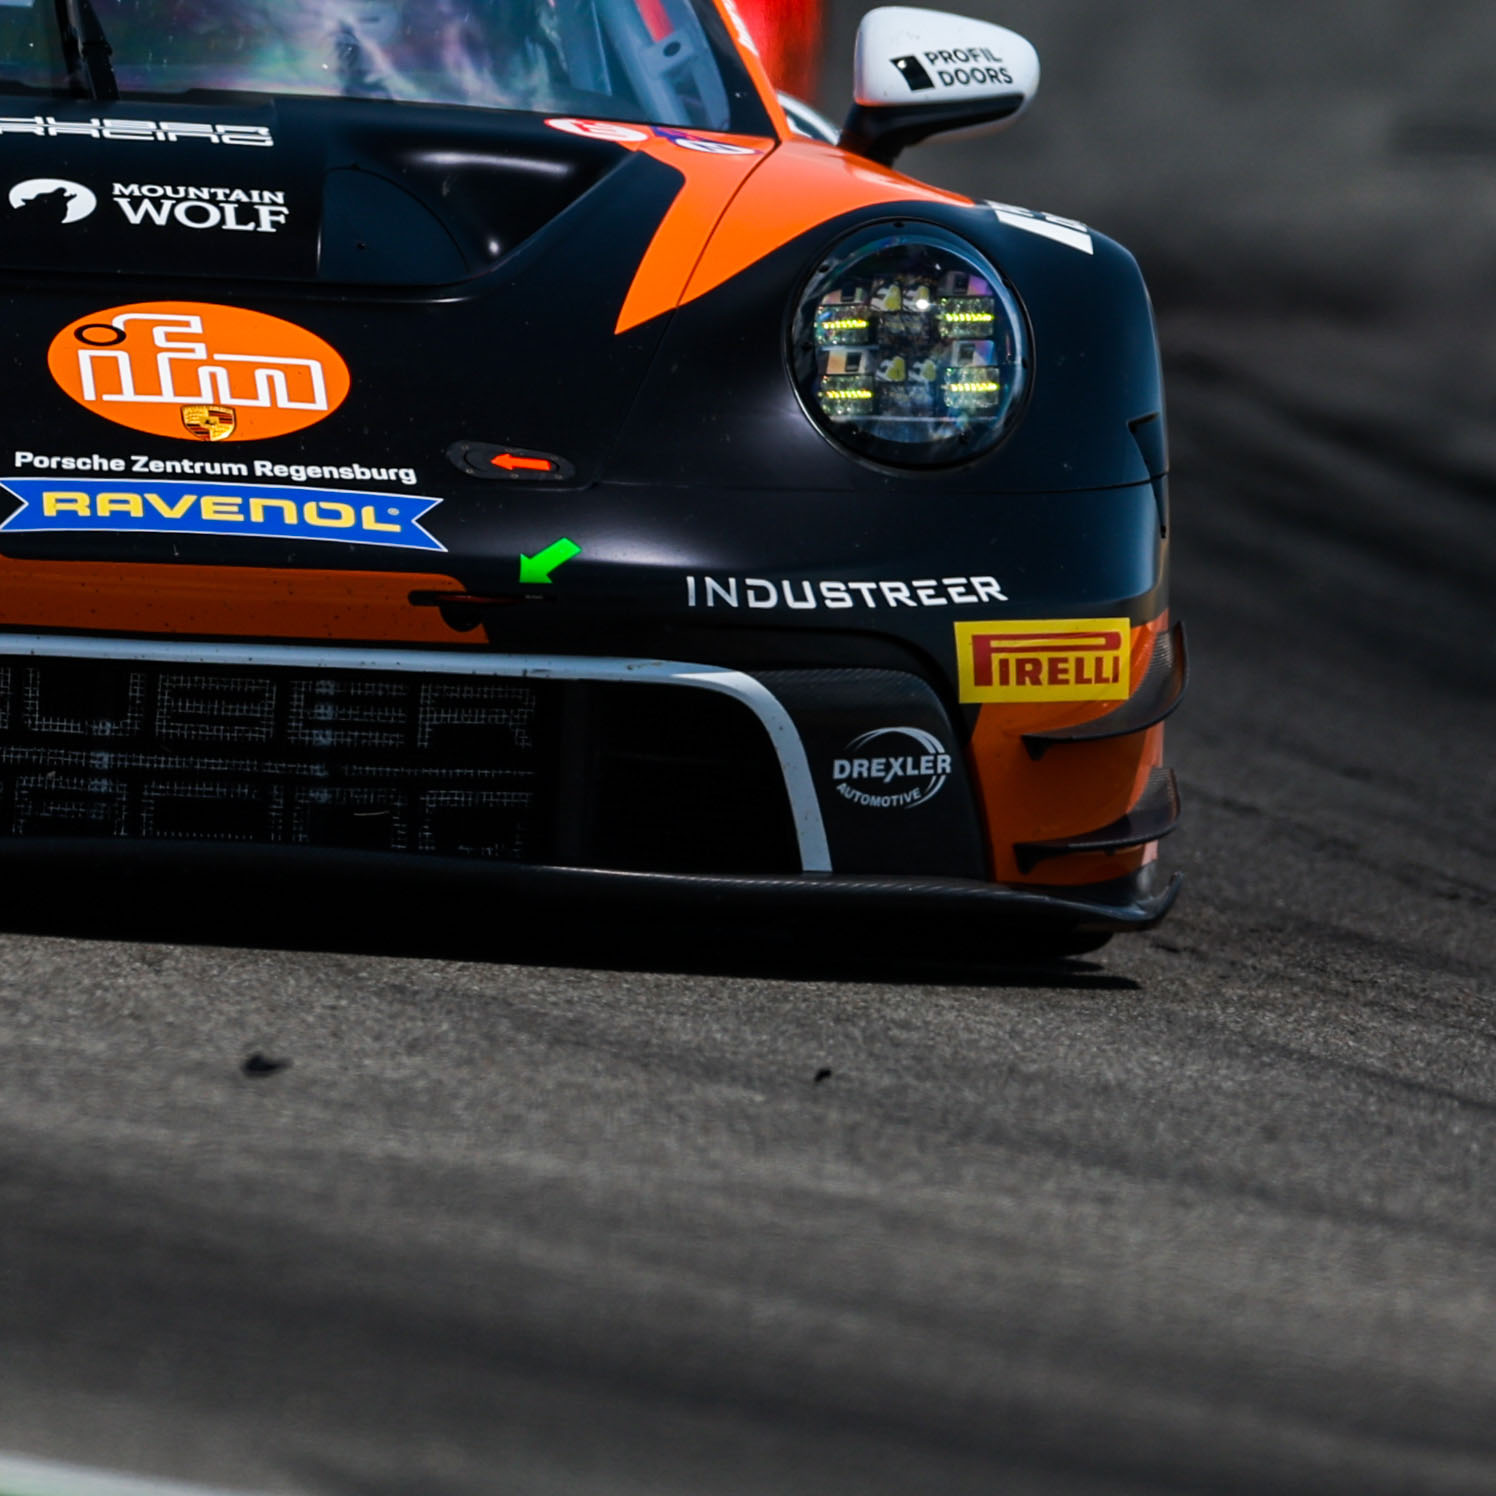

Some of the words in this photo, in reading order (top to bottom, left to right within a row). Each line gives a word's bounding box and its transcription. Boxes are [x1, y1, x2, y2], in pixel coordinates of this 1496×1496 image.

[923, 47, 1003, 66] PROFIL
[936, 67, 1013, 87] DOORS
[112, 183, 285, 204] MOUNTAIN
[113, 197, 289, 232] WOLF
[14, 450, 124, 472] Porsche
[131, 455, 248, 478] Zentrum
[254, 461, 417, 485] Regensburg
[686, 576, 1008, 609] INDUSTREER
[971, 631, 1121, 687] PIRELLI
[832, 753, 952, 783] DREXLER
[835, 781, 922, 808] AUTOMOTIVE
